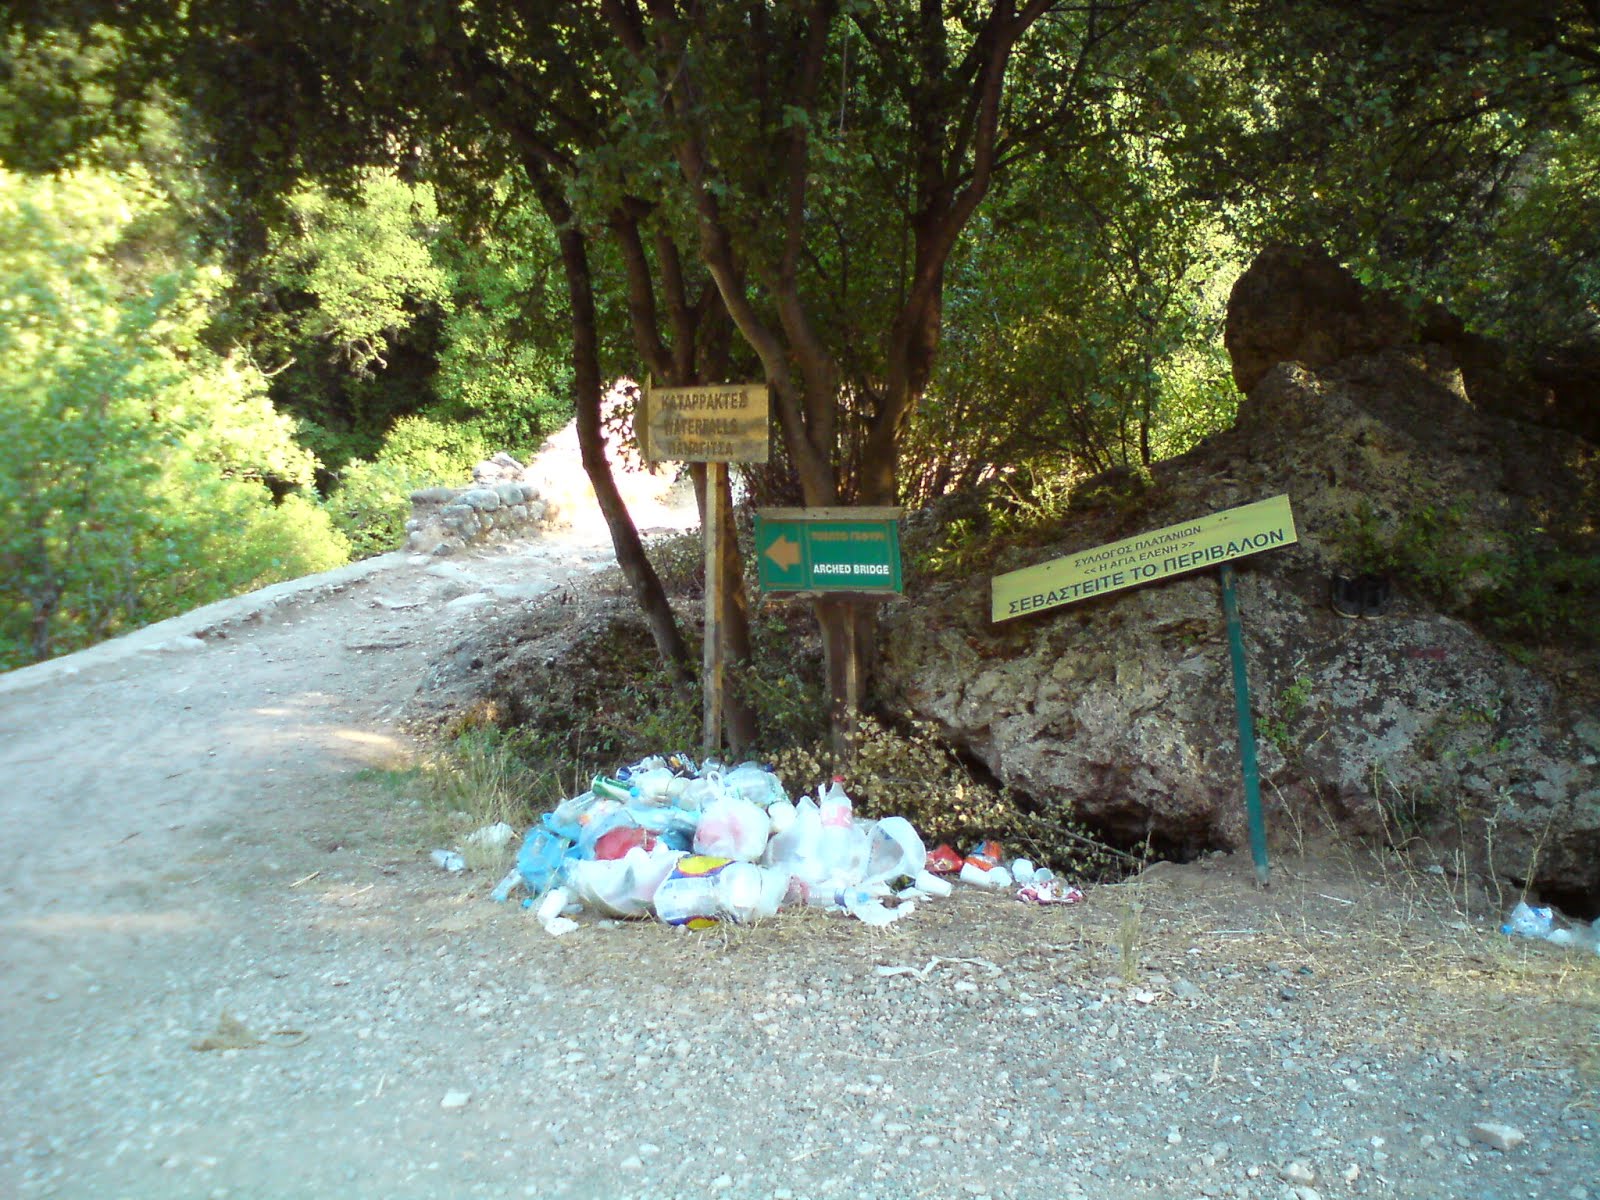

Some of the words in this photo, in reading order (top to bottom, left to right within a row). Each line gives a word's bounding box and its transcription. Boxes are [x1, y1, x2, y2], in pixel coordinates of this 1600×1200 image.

[663, 418, 739, 436] WATERFALLS
[1075, 545, 1133, 567] ΣΥΛΛΟΓΟΣ
[1135, 525, 1201, 550] ΠΛΑΤΑΝΙΩΝ
[1110, 556, 1136, 569] ΑΓΙΑ
[1139, 544, 1178, 561] ΕΛΕΝΗ
[813, 564, 851, 574] ARCHED
[854, 564, 890, 575] BRIDGE
[1008, 571, 1124, 614] ΣΕΒΑΣΤΕΙΤΕ
[1130, 563, 1157, 580] ΤΟ
[1163, 528, 1284, 573] ΠΕΡΙΒΑΛΟΝ
